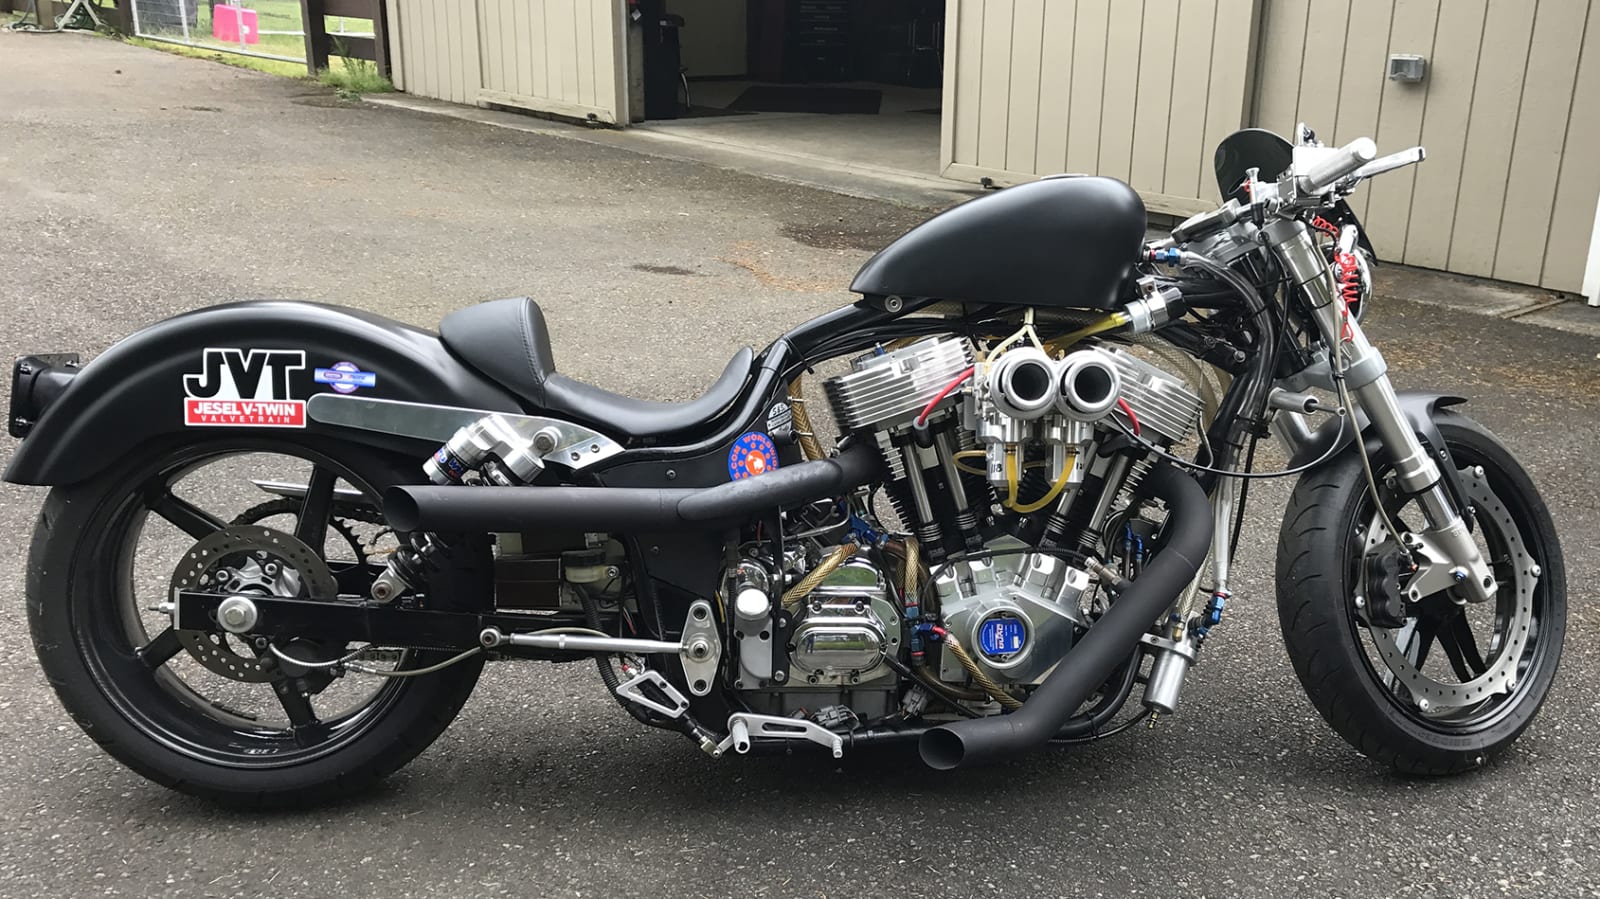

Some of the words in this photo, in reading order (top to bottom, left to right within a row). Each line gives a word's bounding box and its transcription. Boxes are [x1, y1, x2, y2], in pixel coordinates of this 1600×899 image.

[184, 349, 304, 400] JVT
[194, 402, 242, 415] JESEL
[242, 402, 296, 416] V-TWIN
[201, 415, 290, 424] VALVETRAIN
